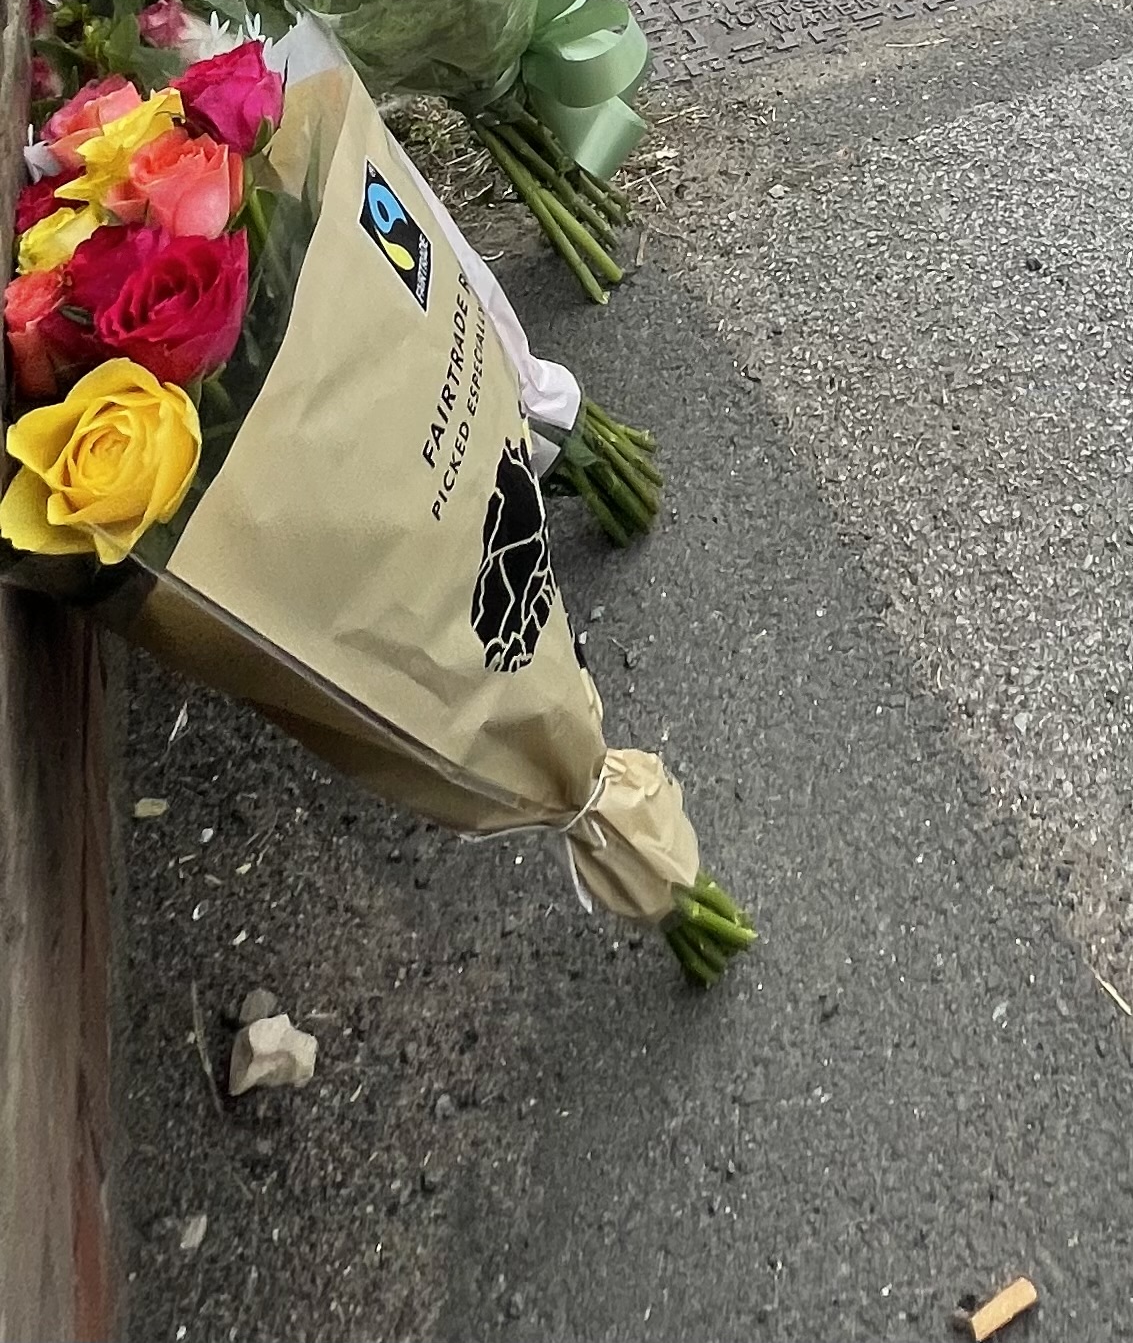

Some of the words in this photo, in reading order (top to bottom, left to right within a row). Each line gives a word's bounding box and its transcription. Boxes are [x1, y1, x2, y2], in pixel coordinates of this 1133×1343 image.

[415, 233, 429, 304] FAIRTRADE
[421, 293, 469, 469] FAIRTRADE
[431, 421, 470, 522] PICKED
